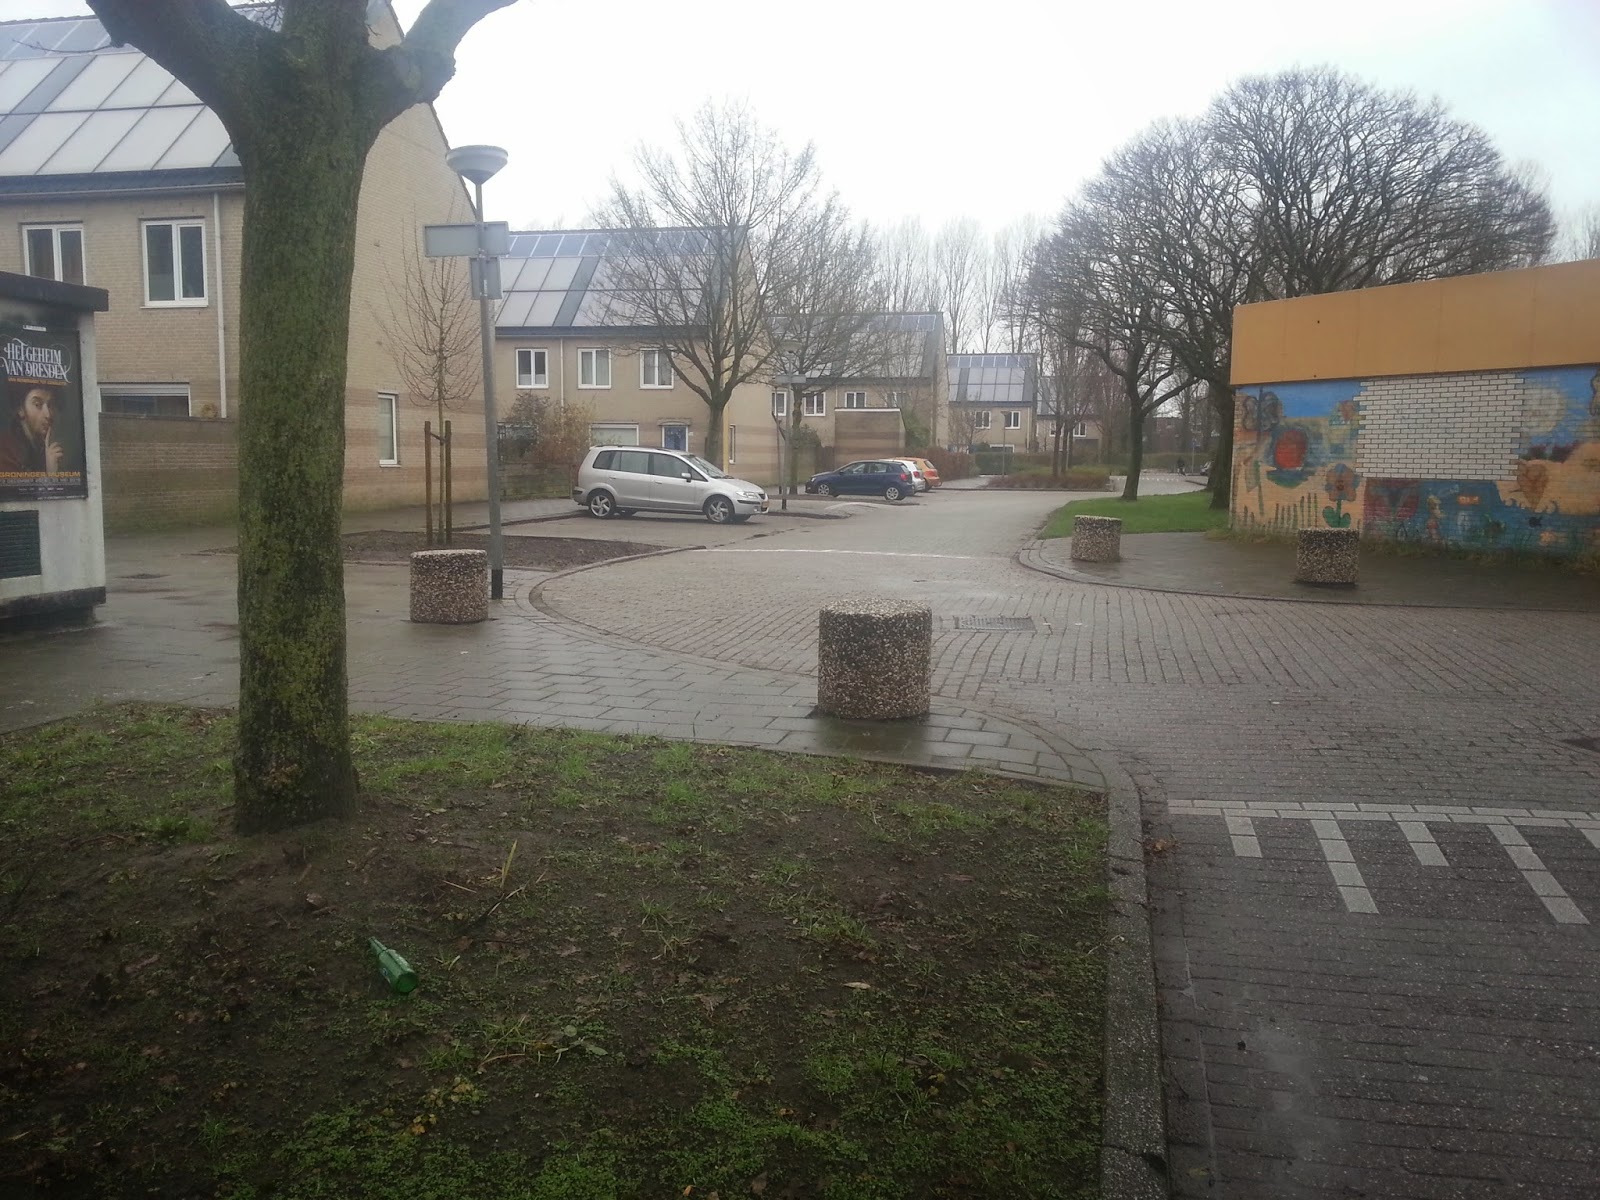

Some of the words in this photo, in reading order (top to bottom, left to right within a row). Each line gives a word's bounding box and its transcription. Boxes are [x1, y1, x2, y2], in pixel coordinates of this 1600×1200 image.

[4, 338, 26, 361] HET
[26, 346, 61, 364] GEHEIM
[0, 357, 24, 376] VAN
[25, 361, 69, 382] DRESDEN
